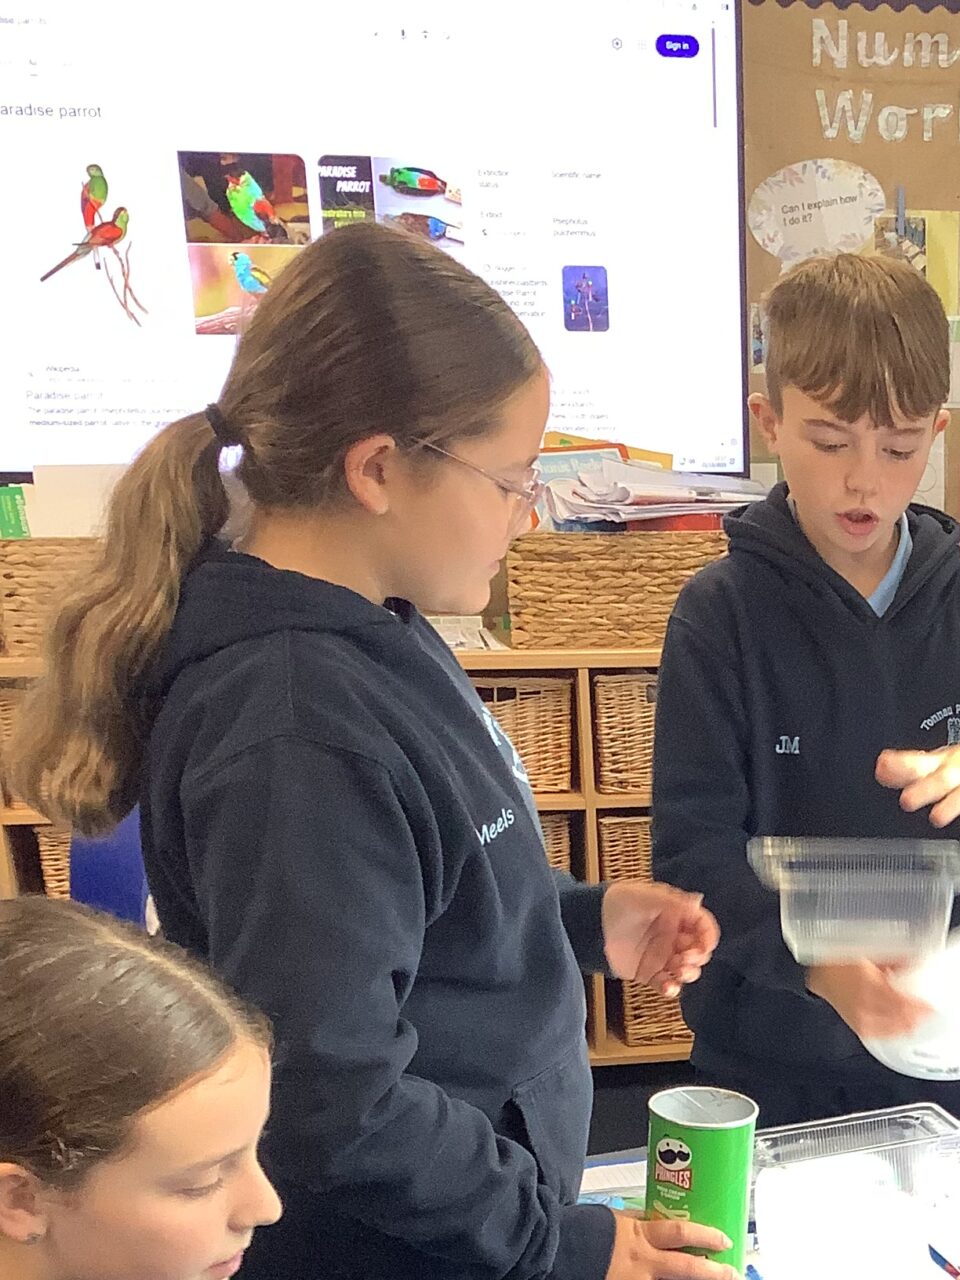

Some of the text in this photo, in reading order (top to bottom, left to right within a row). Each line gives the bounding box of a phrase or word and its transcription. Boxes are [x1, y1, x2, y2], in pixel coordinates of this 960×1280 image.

[666, 41, 690, 51] Sign in
[0, 103, 102, 119] aradise parrot
[318, 165, 357, 178] PARADISE
[336, 180, 371, 193] PARROT
[781, 203, 800, 214] Can
[807, 196, 839, 212] explain
[839, 194, 858, 205] how
[788, 215, 800, 225] do
[802, 213, 813, 224] it?
[776, 736, 800, 754] JM
[655, 1165, 691, 1189] PRINGLES
